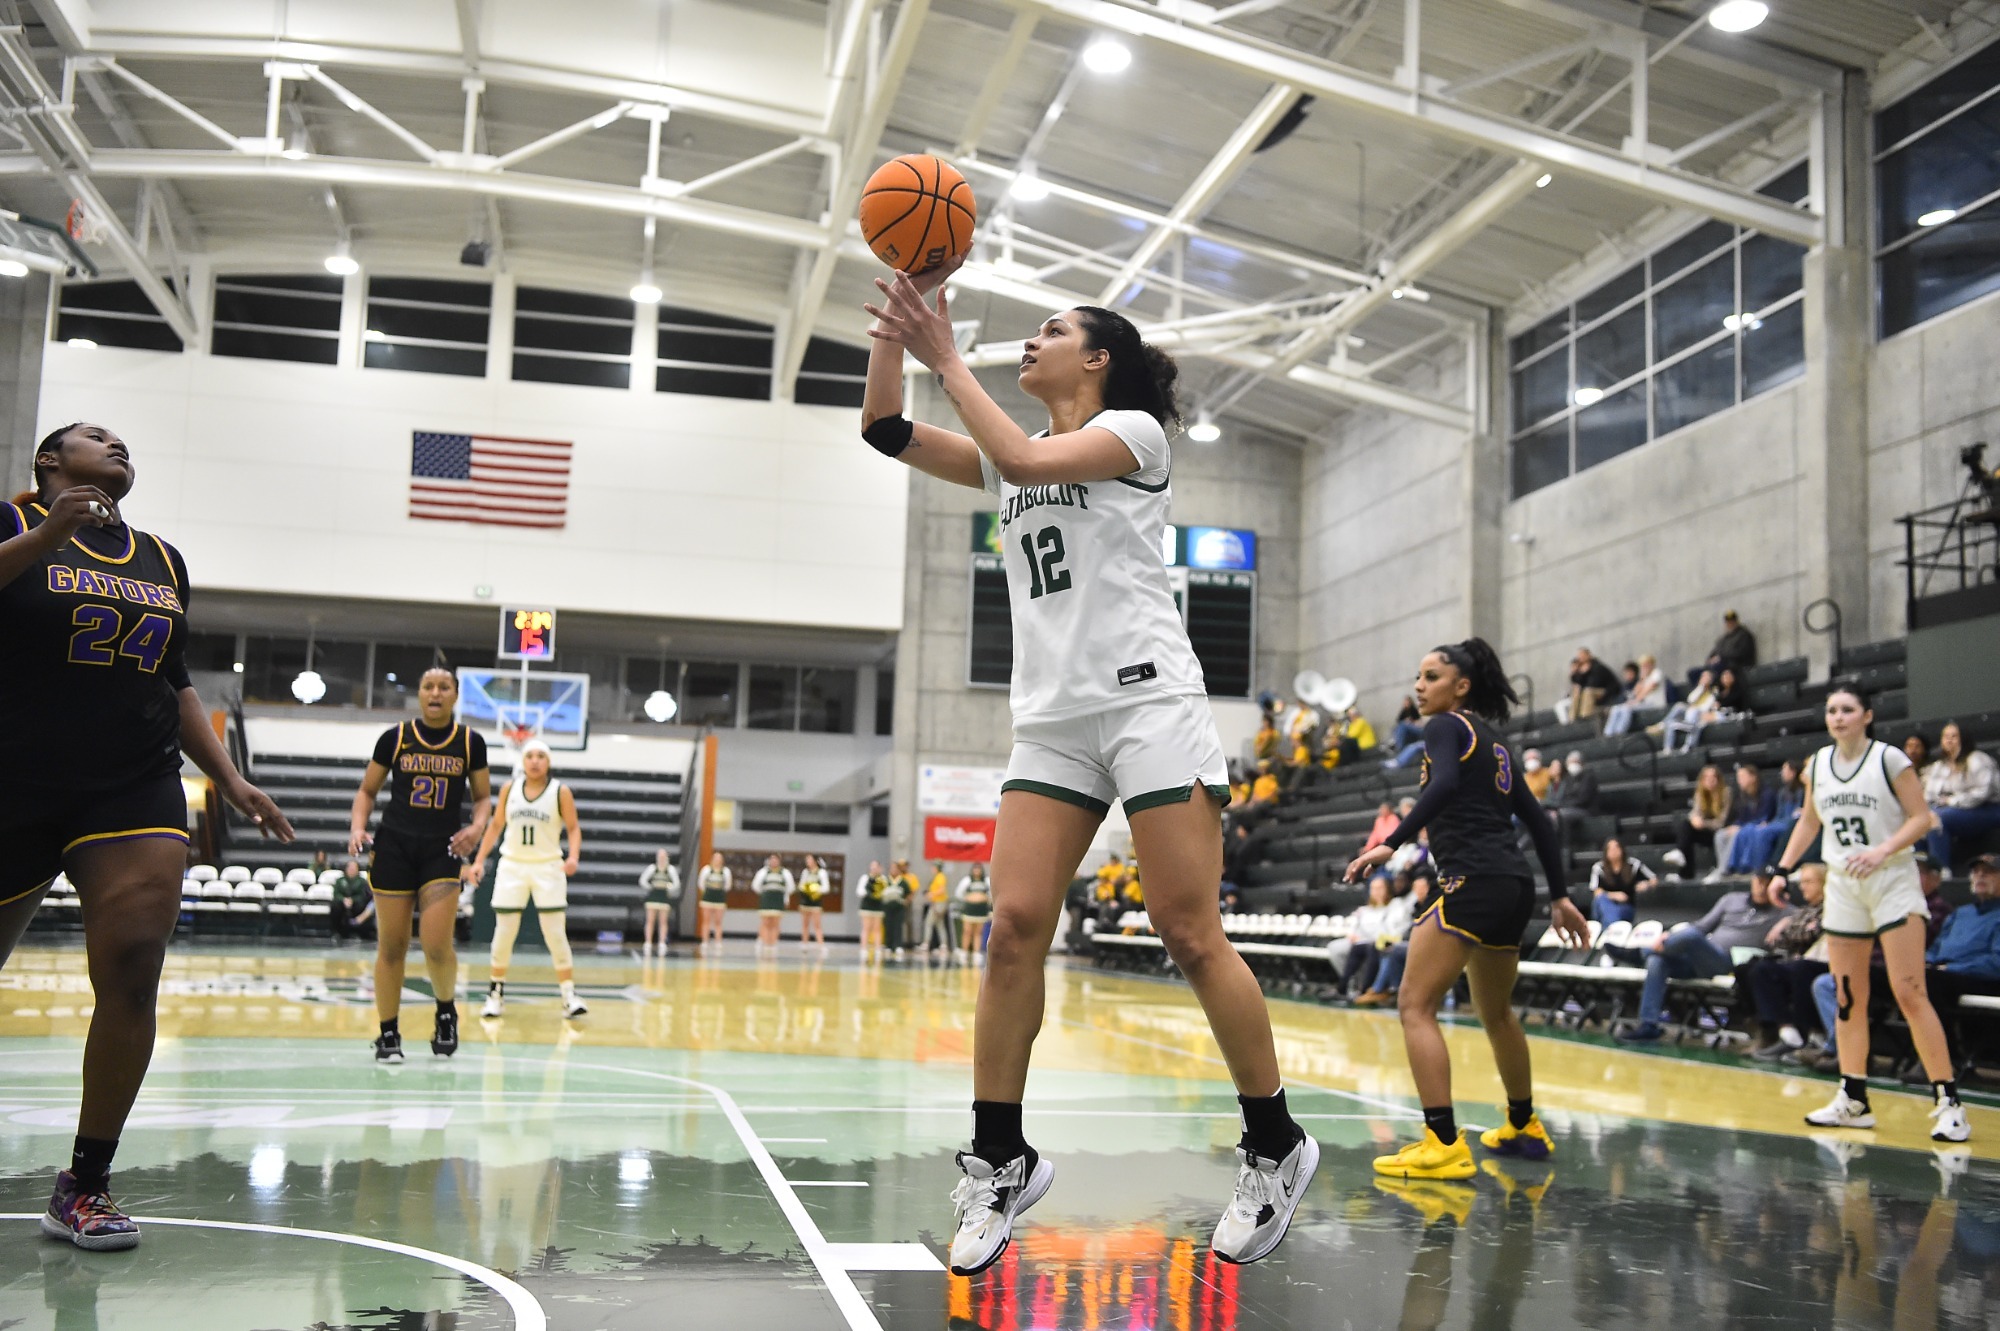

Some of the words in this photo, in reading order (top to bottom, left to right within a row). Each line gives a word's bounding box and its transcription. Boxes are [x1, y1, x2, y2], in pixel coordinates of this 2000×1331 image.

[1020, 525, 1072, 600] 12
[48, 564, 183, 614] GATORS
[67, 604, 173, 674] 24
[521, 628, 544, 656] 15
[400, 753, 464, 776] GATORS
[1492, 742, 1512, 794] 3
[410, 775, 449, 810] 21
[522, 824, 534, 846] 11
[1832, 816, 1869, 847] 23
